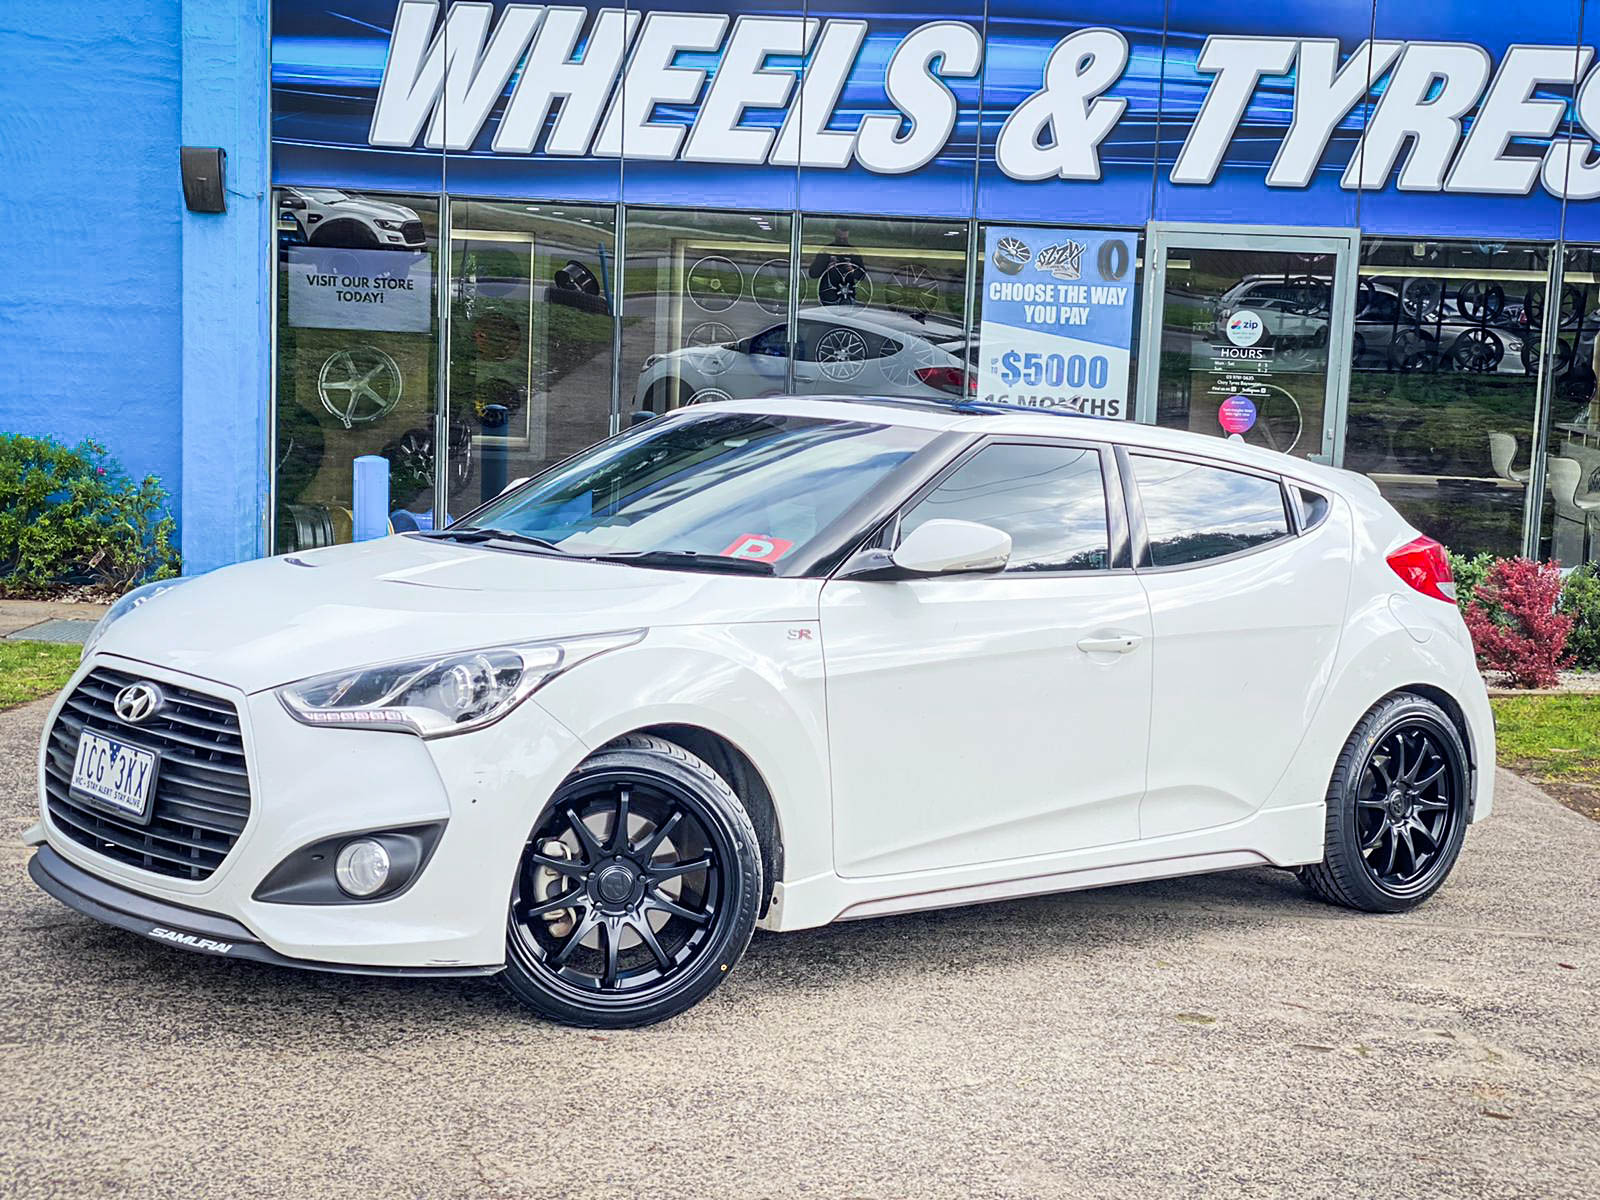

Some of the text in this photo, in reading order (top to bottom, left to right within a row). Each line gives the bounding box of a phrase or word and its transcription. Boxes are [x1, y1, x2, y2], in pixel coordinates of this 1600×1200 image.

[368, 0, 984, 174] WHEELS
[995, 27, 1129, 181] &
[306, 274, 414, 290] VISIT OUR STORE
[336, 290, 384, 304] TODAY!
[989, 282, 1128, 306] CHOOSE THE WAY
[1024, 305, 1090, 326] YOU PAY
[1243, 319, 1258, 330] zip
[1221, 348, 1263, 359] HOURS
[1001, 349, 1109, 390] $5000
[730, 538, 775, 559] P
[787, 628, 813, 640] SR
[115, 755, 148, 799] 3KX
[86, 781, 98, 791] STAY
[98, 785, 113, 795] ALERT
[114, 791, 126, 801] STAY
[127, 796, 140, 808] ALIVE
[148, 927, 233, 953] SAMURAI
